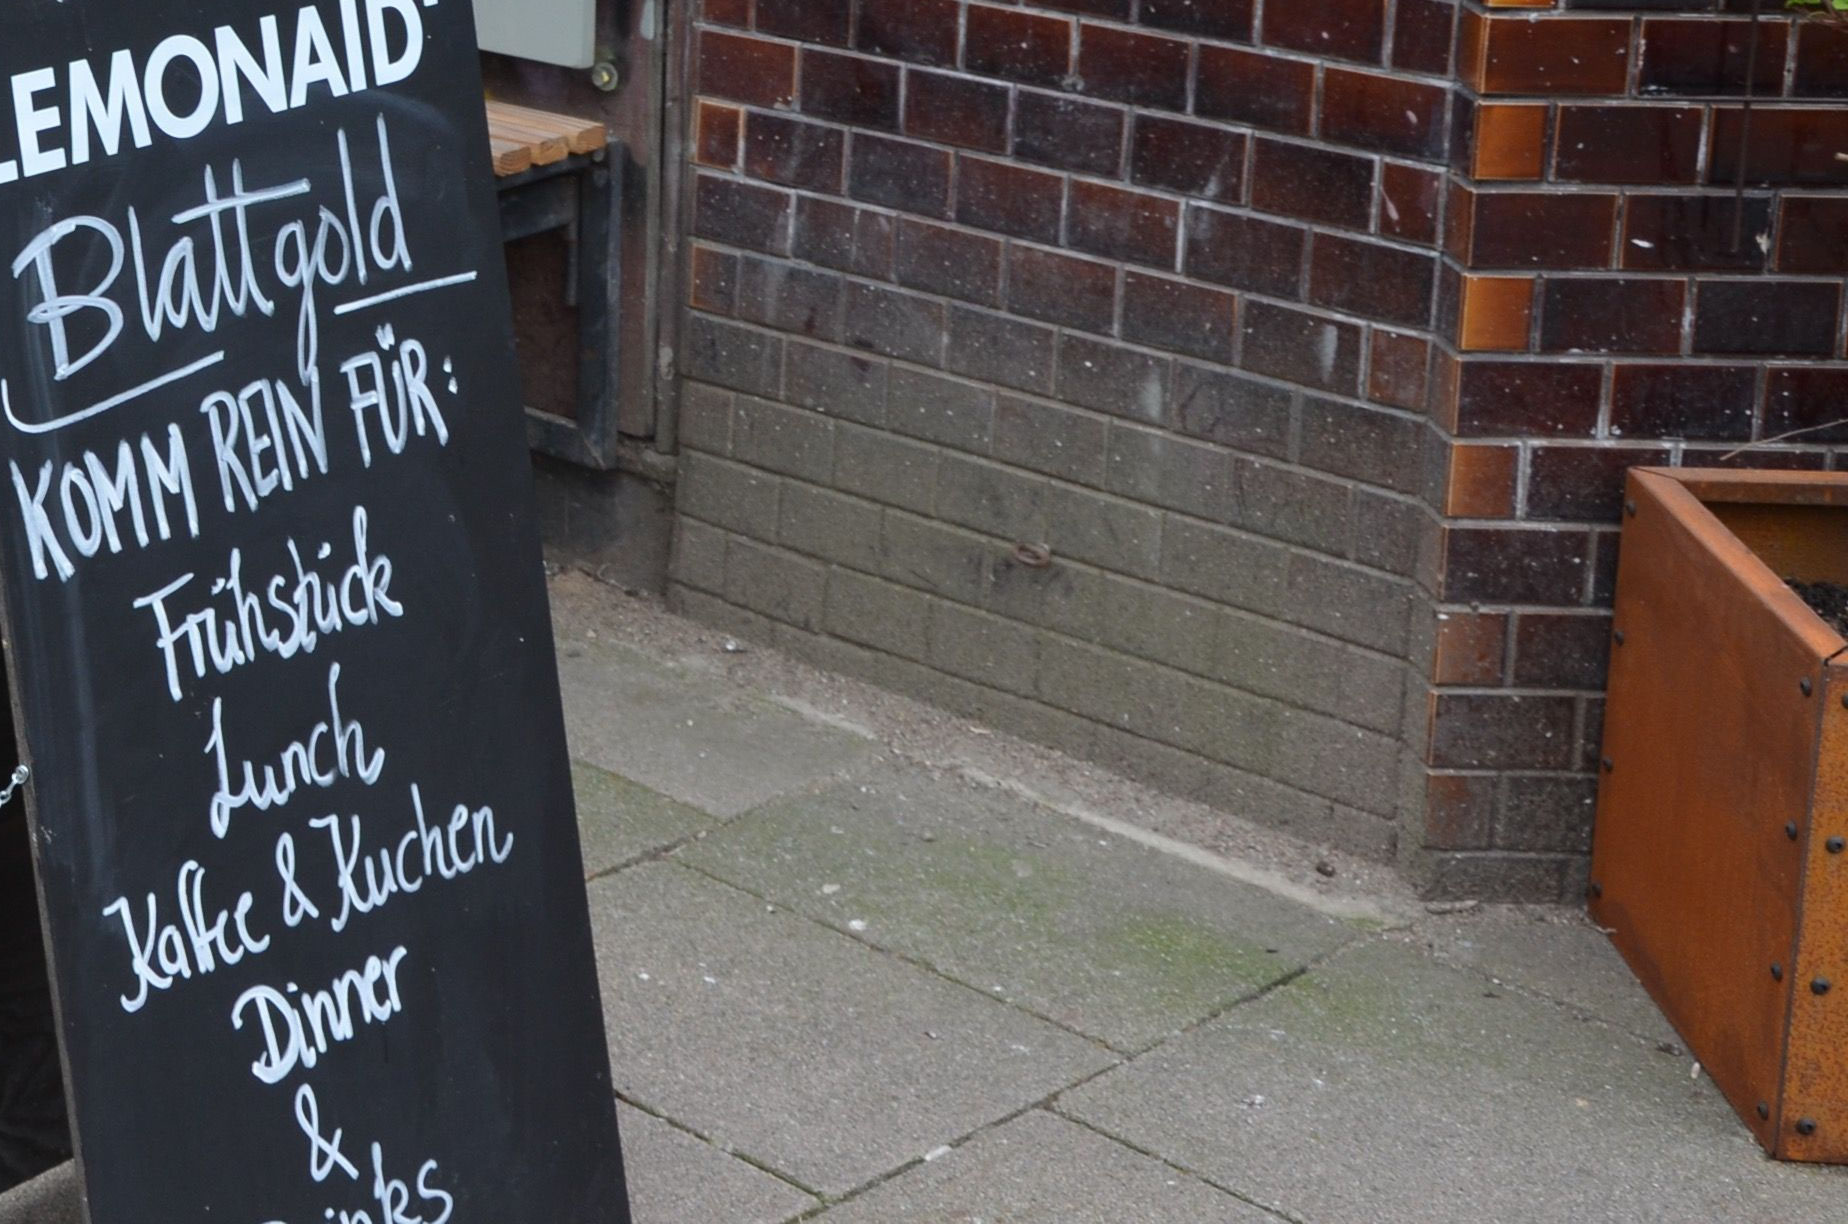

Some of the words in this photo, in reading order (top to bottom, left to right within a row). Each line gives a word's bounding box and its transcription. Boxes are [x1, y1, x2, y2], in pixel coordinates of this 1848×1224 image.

[10, 112, 415, 384] Blattgold
[9, 422, 200, 583] KOMM
[199, 367, 329, 514] REIN
[339, 322, 459, 469] FÜR:
[132, 505, 405, 702] Frühstück
[204, 661, 387, 839] Lunch
[102, 859, 271, 1012] Kaffee
[275, 832, 320, 927] &
[308, 782, 515, 933] Kuchen
[231, 944, 408, 1084] Dinner
[294, 1083, 360, 1182] &
